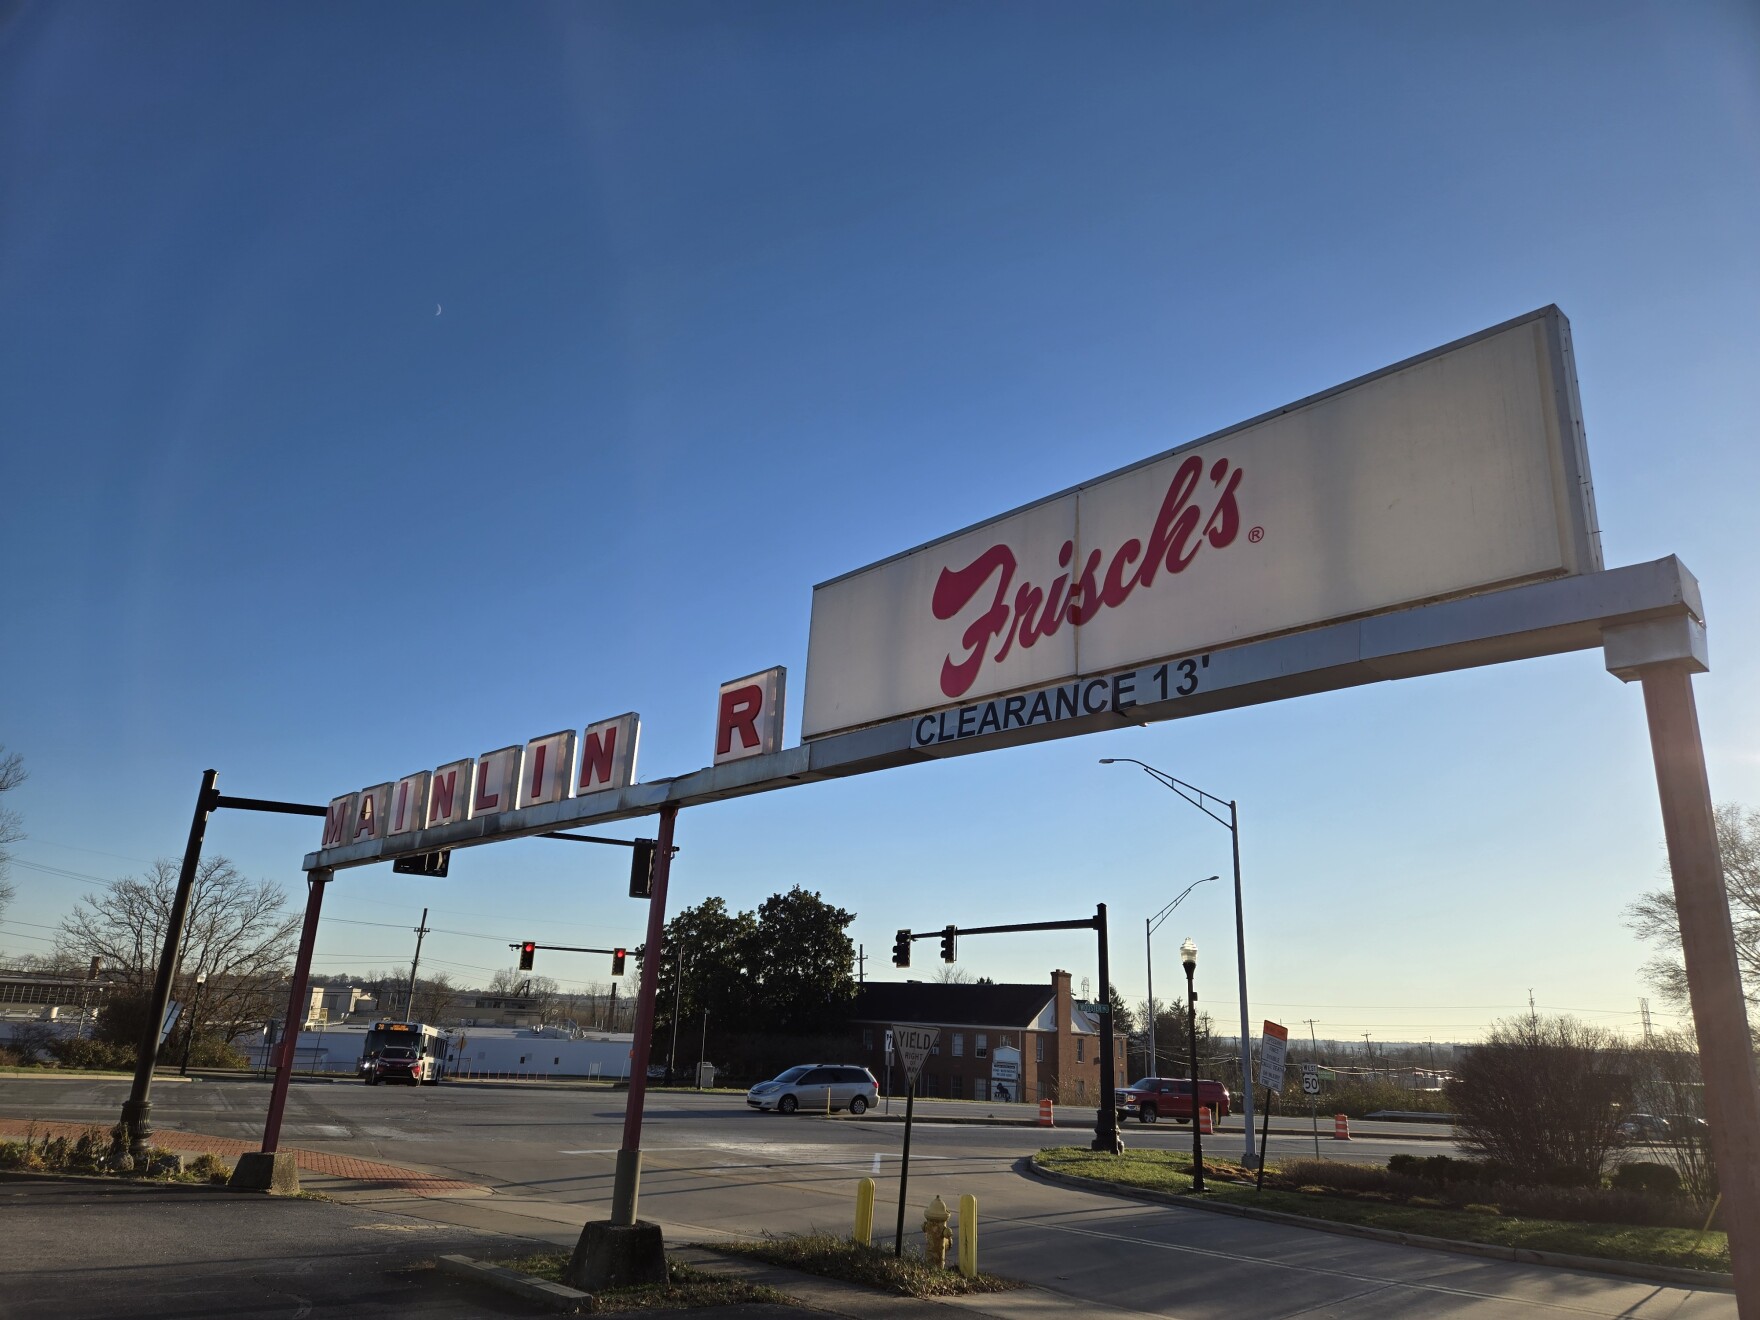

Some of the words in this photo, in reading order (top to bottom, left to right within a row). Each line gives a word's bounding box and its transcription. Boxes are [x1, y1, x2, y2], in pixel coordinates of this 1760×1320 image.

[932, 455, 1243, 697] Frisch's
[915, 671, 1137, 746] CLEARANCE
[1153, 654, 1210, 700] 13'
[898, 1030, 931, 1050] YIELD
[904, 1052, 923, 1061] RIGHT
[1303, 1064, 1316, 1072] WEST
[1305, 1077, 1318, 1090] 50
